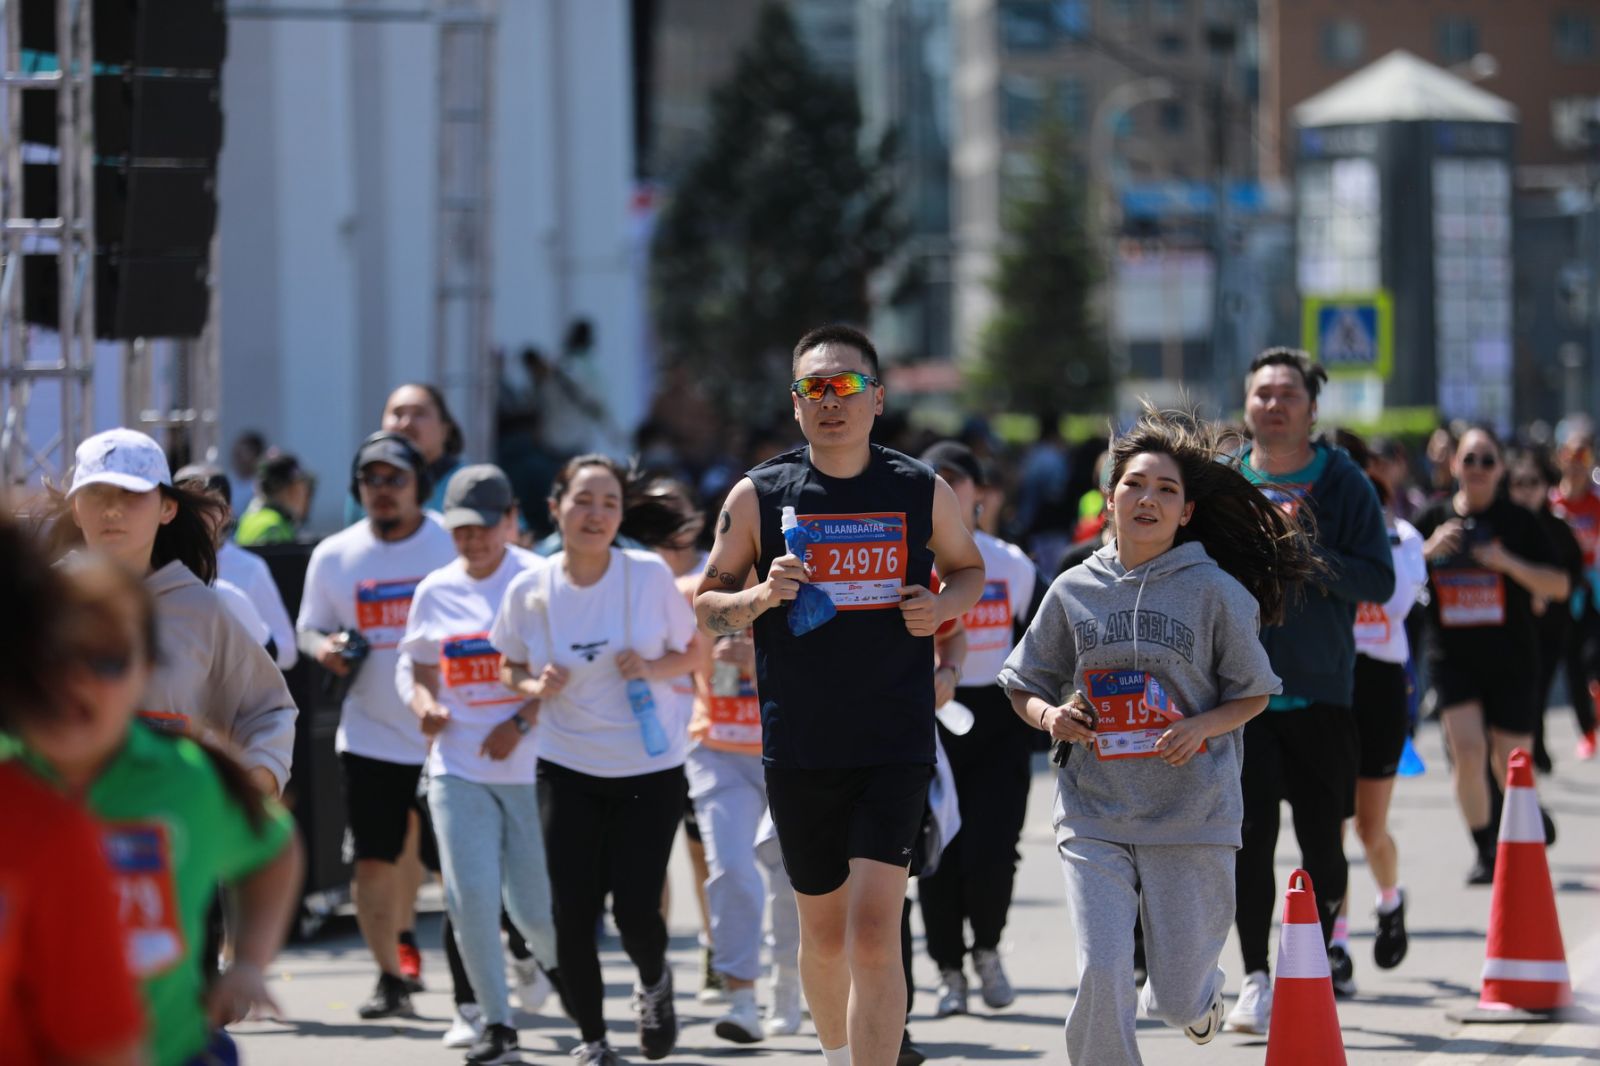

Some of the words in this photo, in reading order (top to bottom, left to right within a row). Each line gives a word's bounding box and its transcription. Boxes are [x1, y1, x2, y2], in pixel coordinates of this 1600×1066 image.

[824, 523, 885, 534] ULAANBAATAR
[829, 546, 898, 575] 24976
[1103, 610, 1195, 664] ANGELES
[1101, 701, 1111, 712] 5
[1098, 716, 1115, 724] KM
